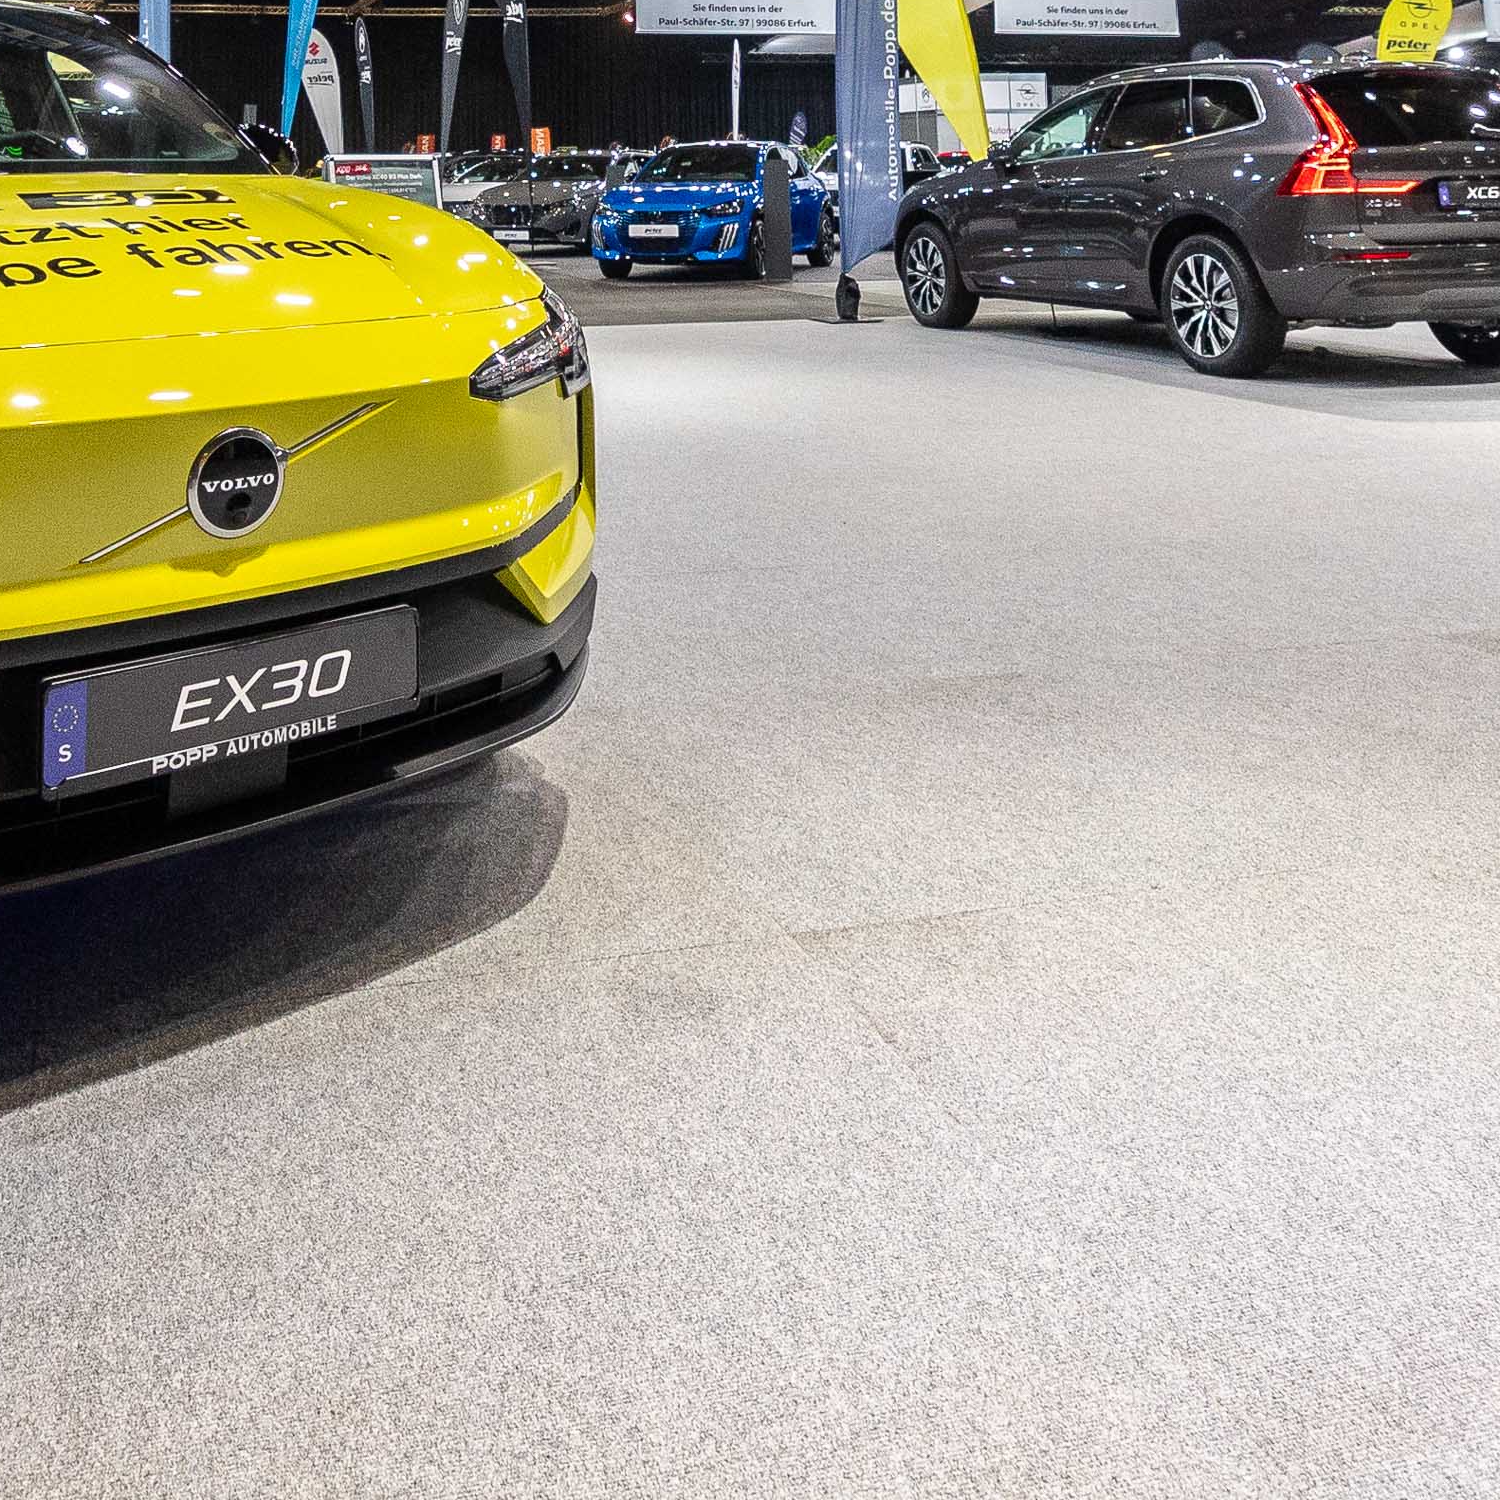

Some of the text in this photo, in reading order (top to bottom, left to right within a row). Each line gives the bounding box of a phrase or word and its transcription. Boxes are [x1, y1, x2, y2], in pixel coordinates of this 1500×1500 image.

[692, 4, 707, 13] Sie
[708, 4, 737, 13] finden
[757, 4, 767, 13] in
[769, 4, 783, 13] der
[1047, 6, 1059, 15] Sie
[1060, 6, 1087, 15] finden
[1105, 7, 1113, 15] in
[1114, 8, 1129, 16] der
[659, 17, 817, 28] Paul-Schäfer-Str. 97 99086 Erfurt.
[1016, 19, 1088, 28] Paul-Schäfer-Str.
[1089, 20, 1099, 28] 97
[1386, 39, 1432, 50] peter
[881, 0, 899, 201] Automobile-Popp.de
[106, 213, 252, 238] hier
[124, 234, 392, 271] fahren.
[202, 473, 276, 494] VOLVO
[170, 648, 353, 732] EX30
[58, 744, 72, 763] S
[152, 715, 338, 775] POPP AUTOMOBILE
